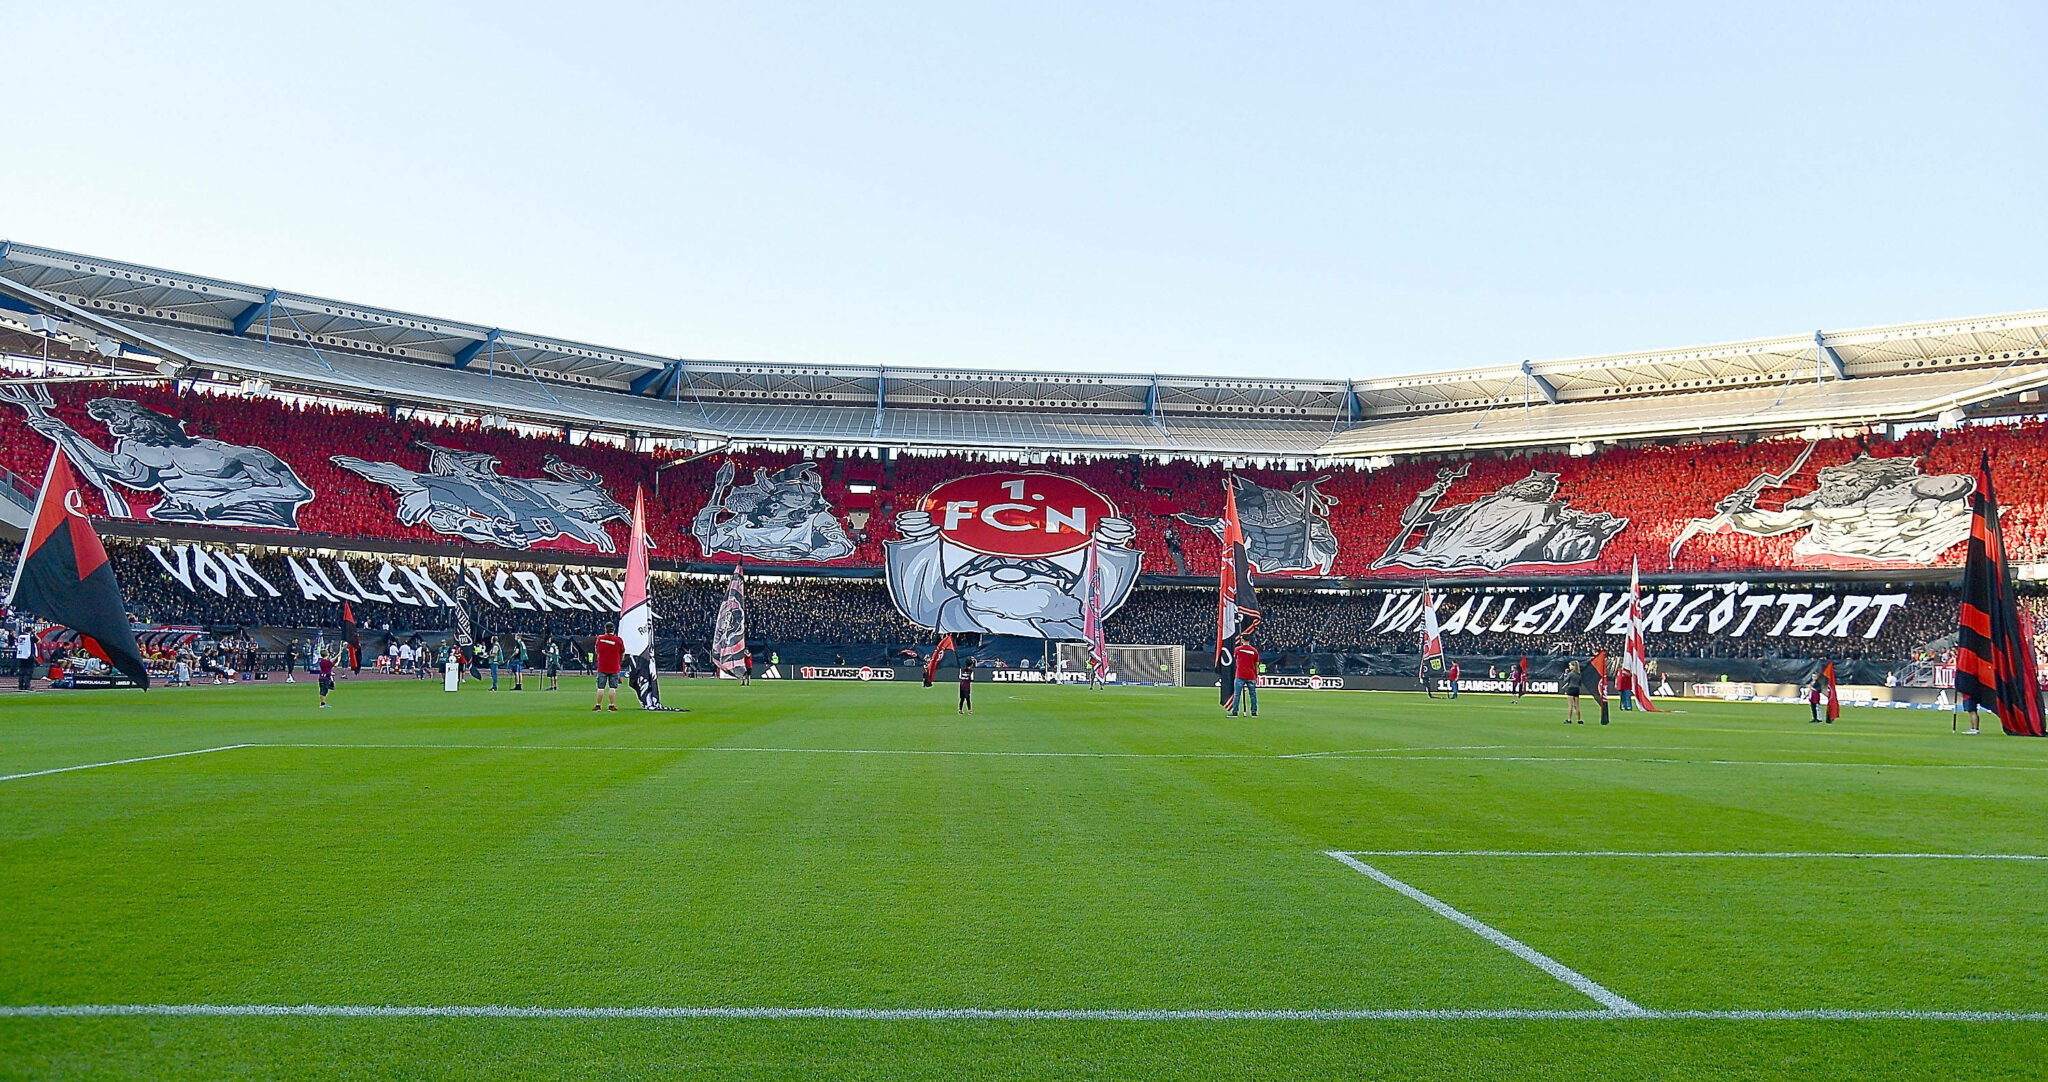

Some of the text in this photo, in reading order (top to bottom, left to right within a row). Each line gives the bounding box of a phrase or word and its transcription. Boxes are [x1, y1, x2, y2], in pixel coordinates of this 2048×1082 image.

[1001, 480, 1045, 501] 1.
[943, 500, 1089, 536] FCN
[146, 543, 663, 620] VON ALLEN VEREHR
[1438, 594, 1585, 636] ALLEN
[1584, 581, 1908, 640] VERGÖTTERT
[1934, 665, 1956, 687] KUL
